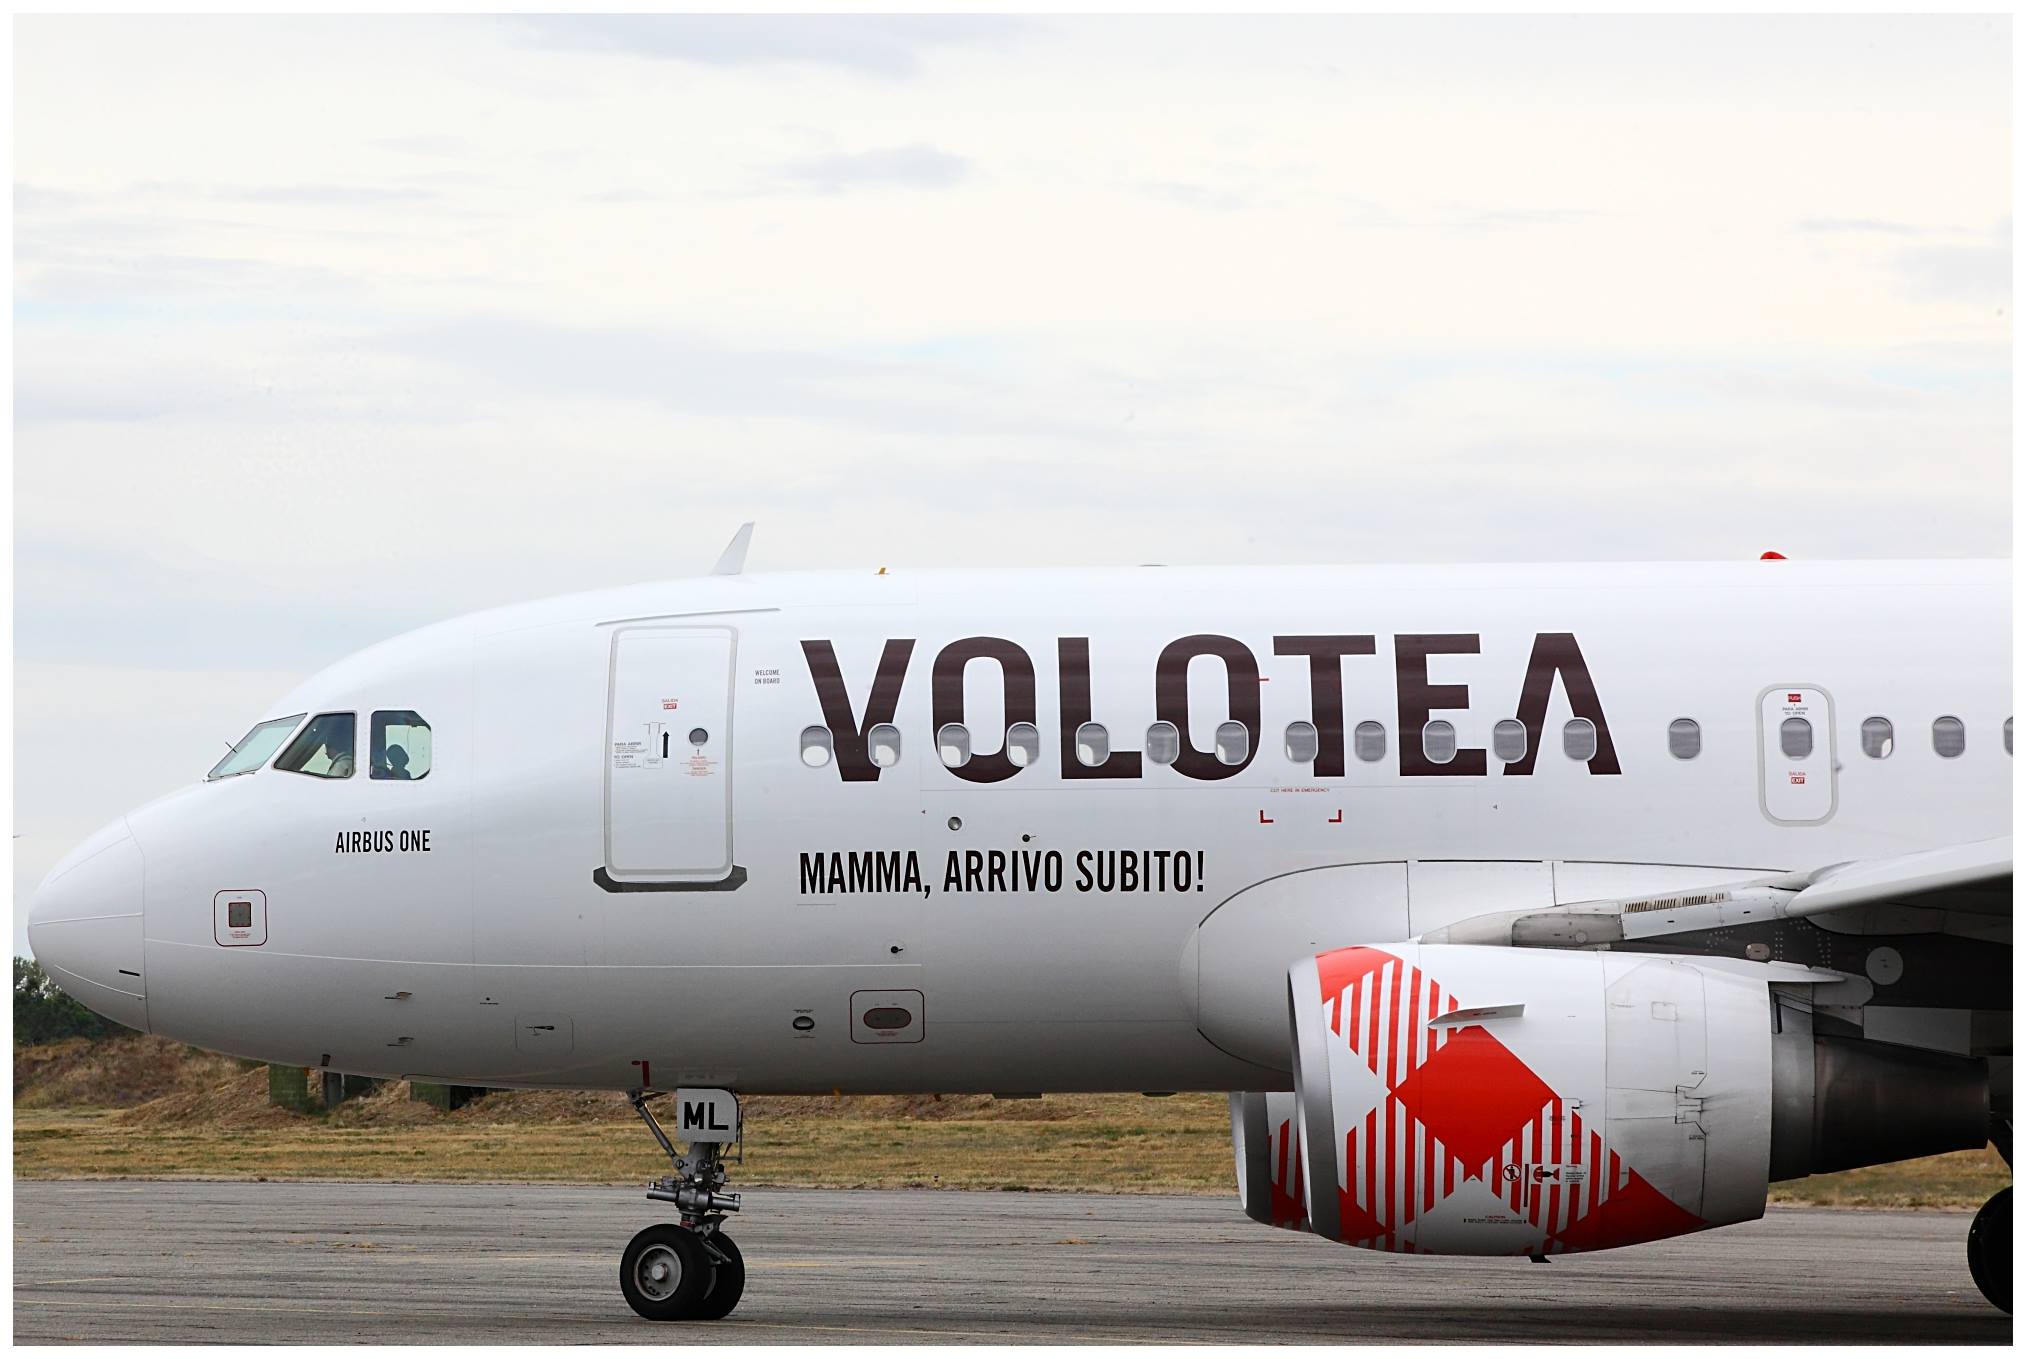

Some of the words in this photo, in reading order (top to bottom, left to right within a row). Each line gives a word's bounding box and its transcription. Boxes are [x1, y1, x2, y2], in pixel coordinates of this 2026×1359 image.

[800, 633, 1622, 784] VOLOTEA
[335, 830, 394, 854] AIRBUS
[399, 829, 431, 852] ONE
[799, 850, 931, 899] MAMMA,
[942, 850, 1063, 893] ARRIVO
[1075, 850, 1205, 893] SUBITO!
[683, 1101, 729, 1131] ML
